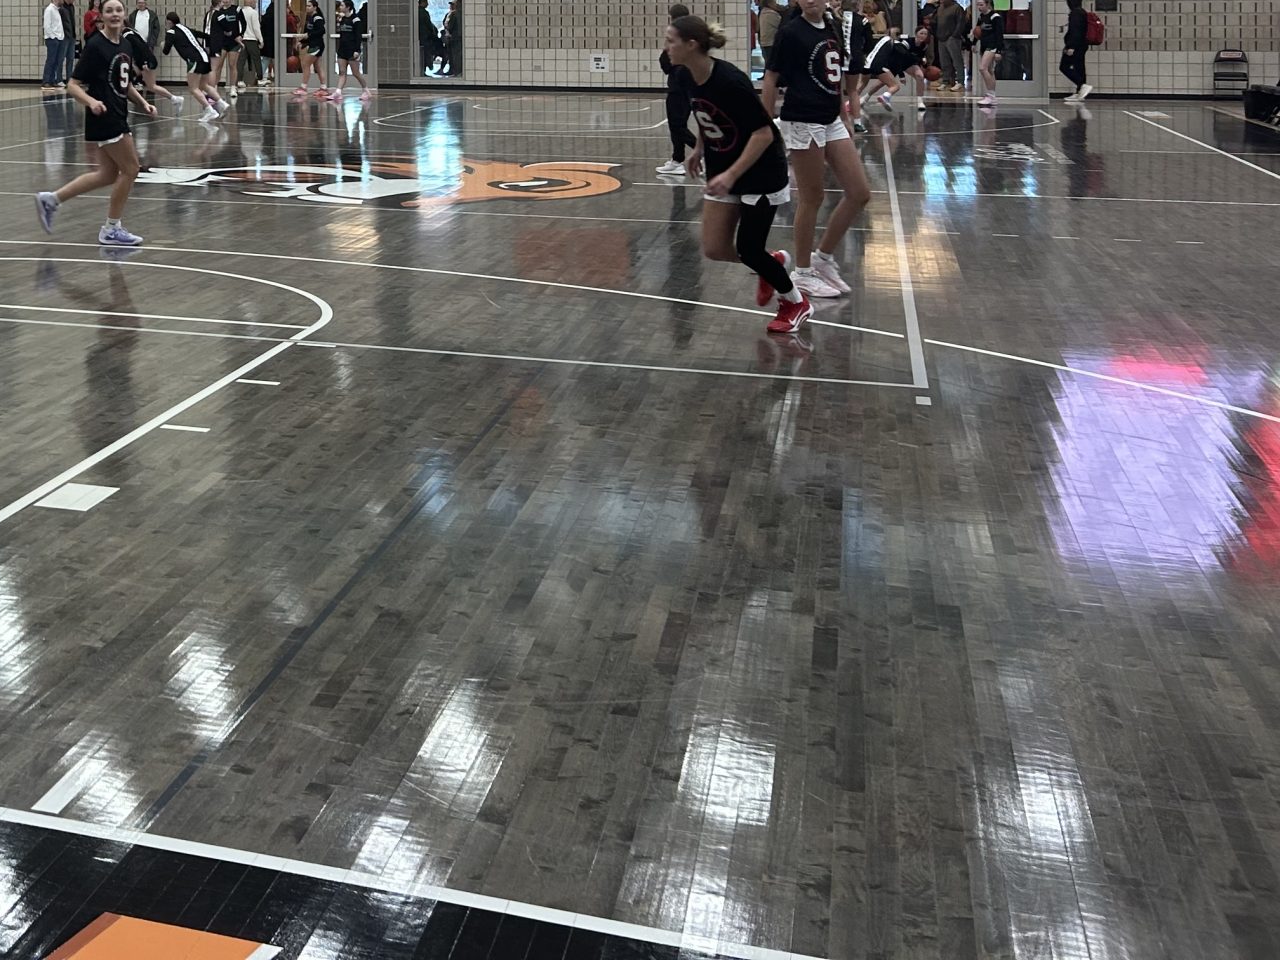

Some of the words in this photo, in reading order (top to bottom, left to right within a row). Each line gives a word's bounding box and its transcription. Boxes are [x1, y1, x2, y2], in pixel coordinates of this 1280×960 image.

[120, 62, 130, 88] S
[825, 51, 841, 83] S
[696, 111, 724, 139] S
